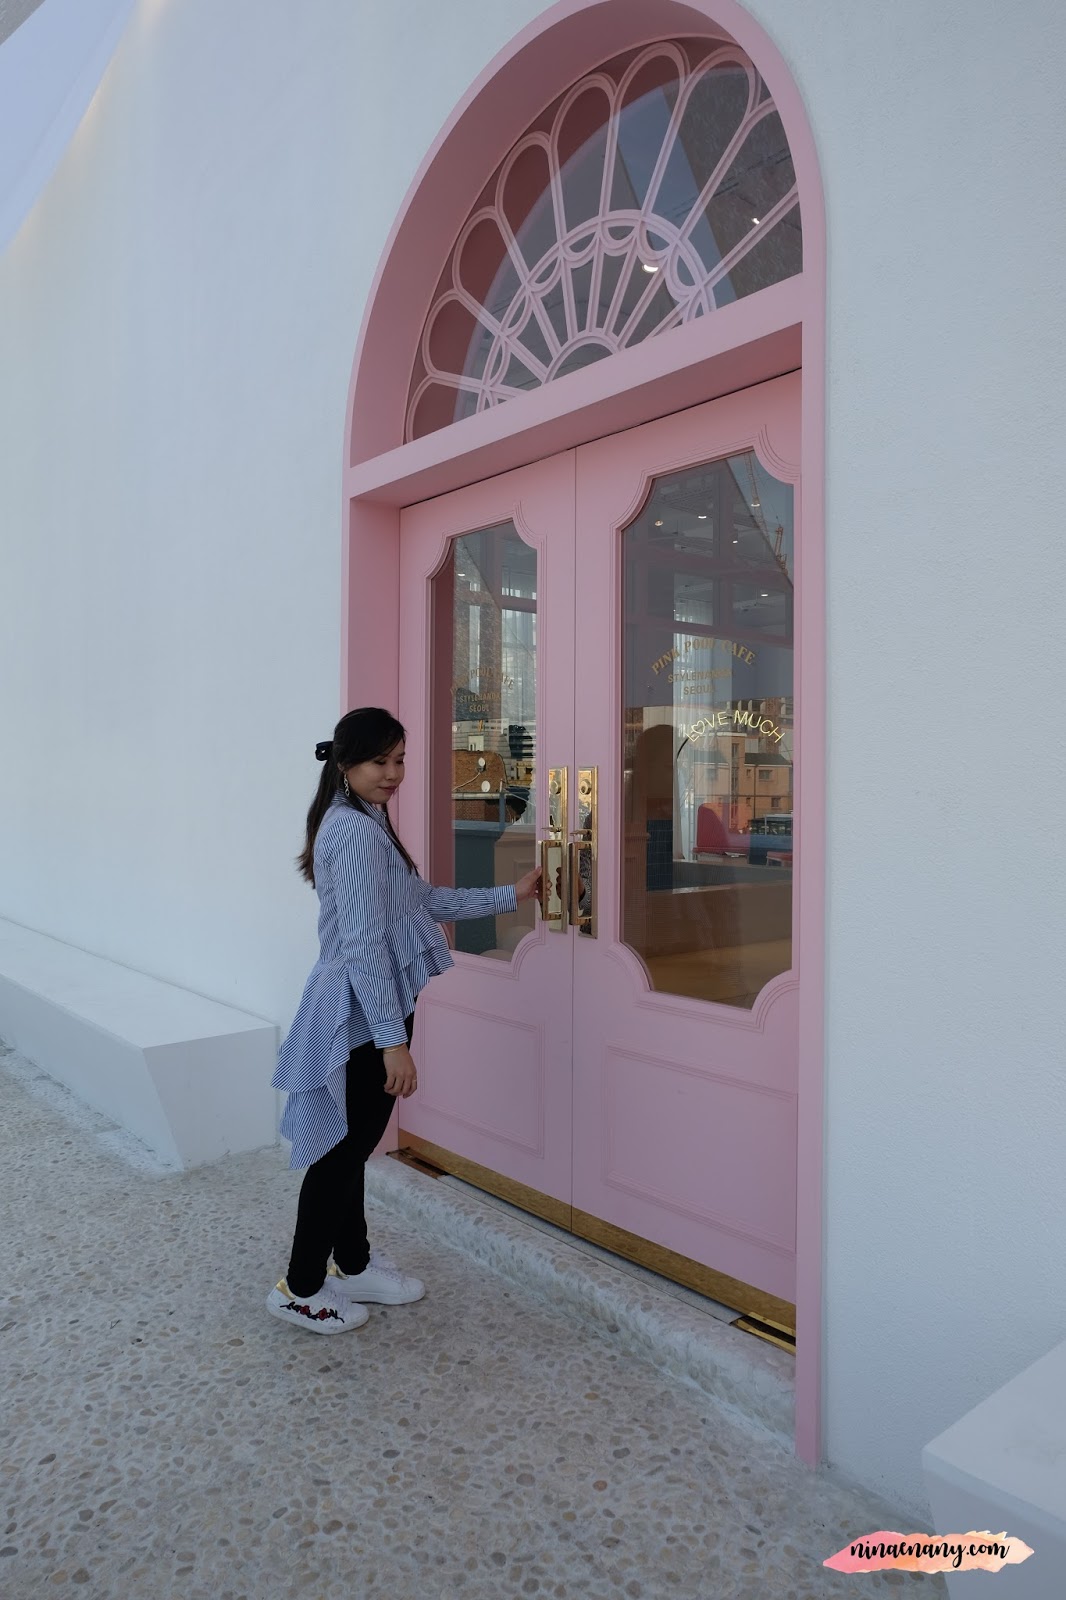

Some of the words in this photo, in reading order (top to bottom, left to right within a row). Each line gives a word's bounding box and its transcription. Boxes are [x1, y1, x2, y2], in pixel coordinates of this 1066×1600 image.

[651, 647, 681, 675] PINK
[721, 639, 756, 665] CAFE
[667, 669, 733, 683] STYLENAN
[734, 710, 785, 743] MUCH
